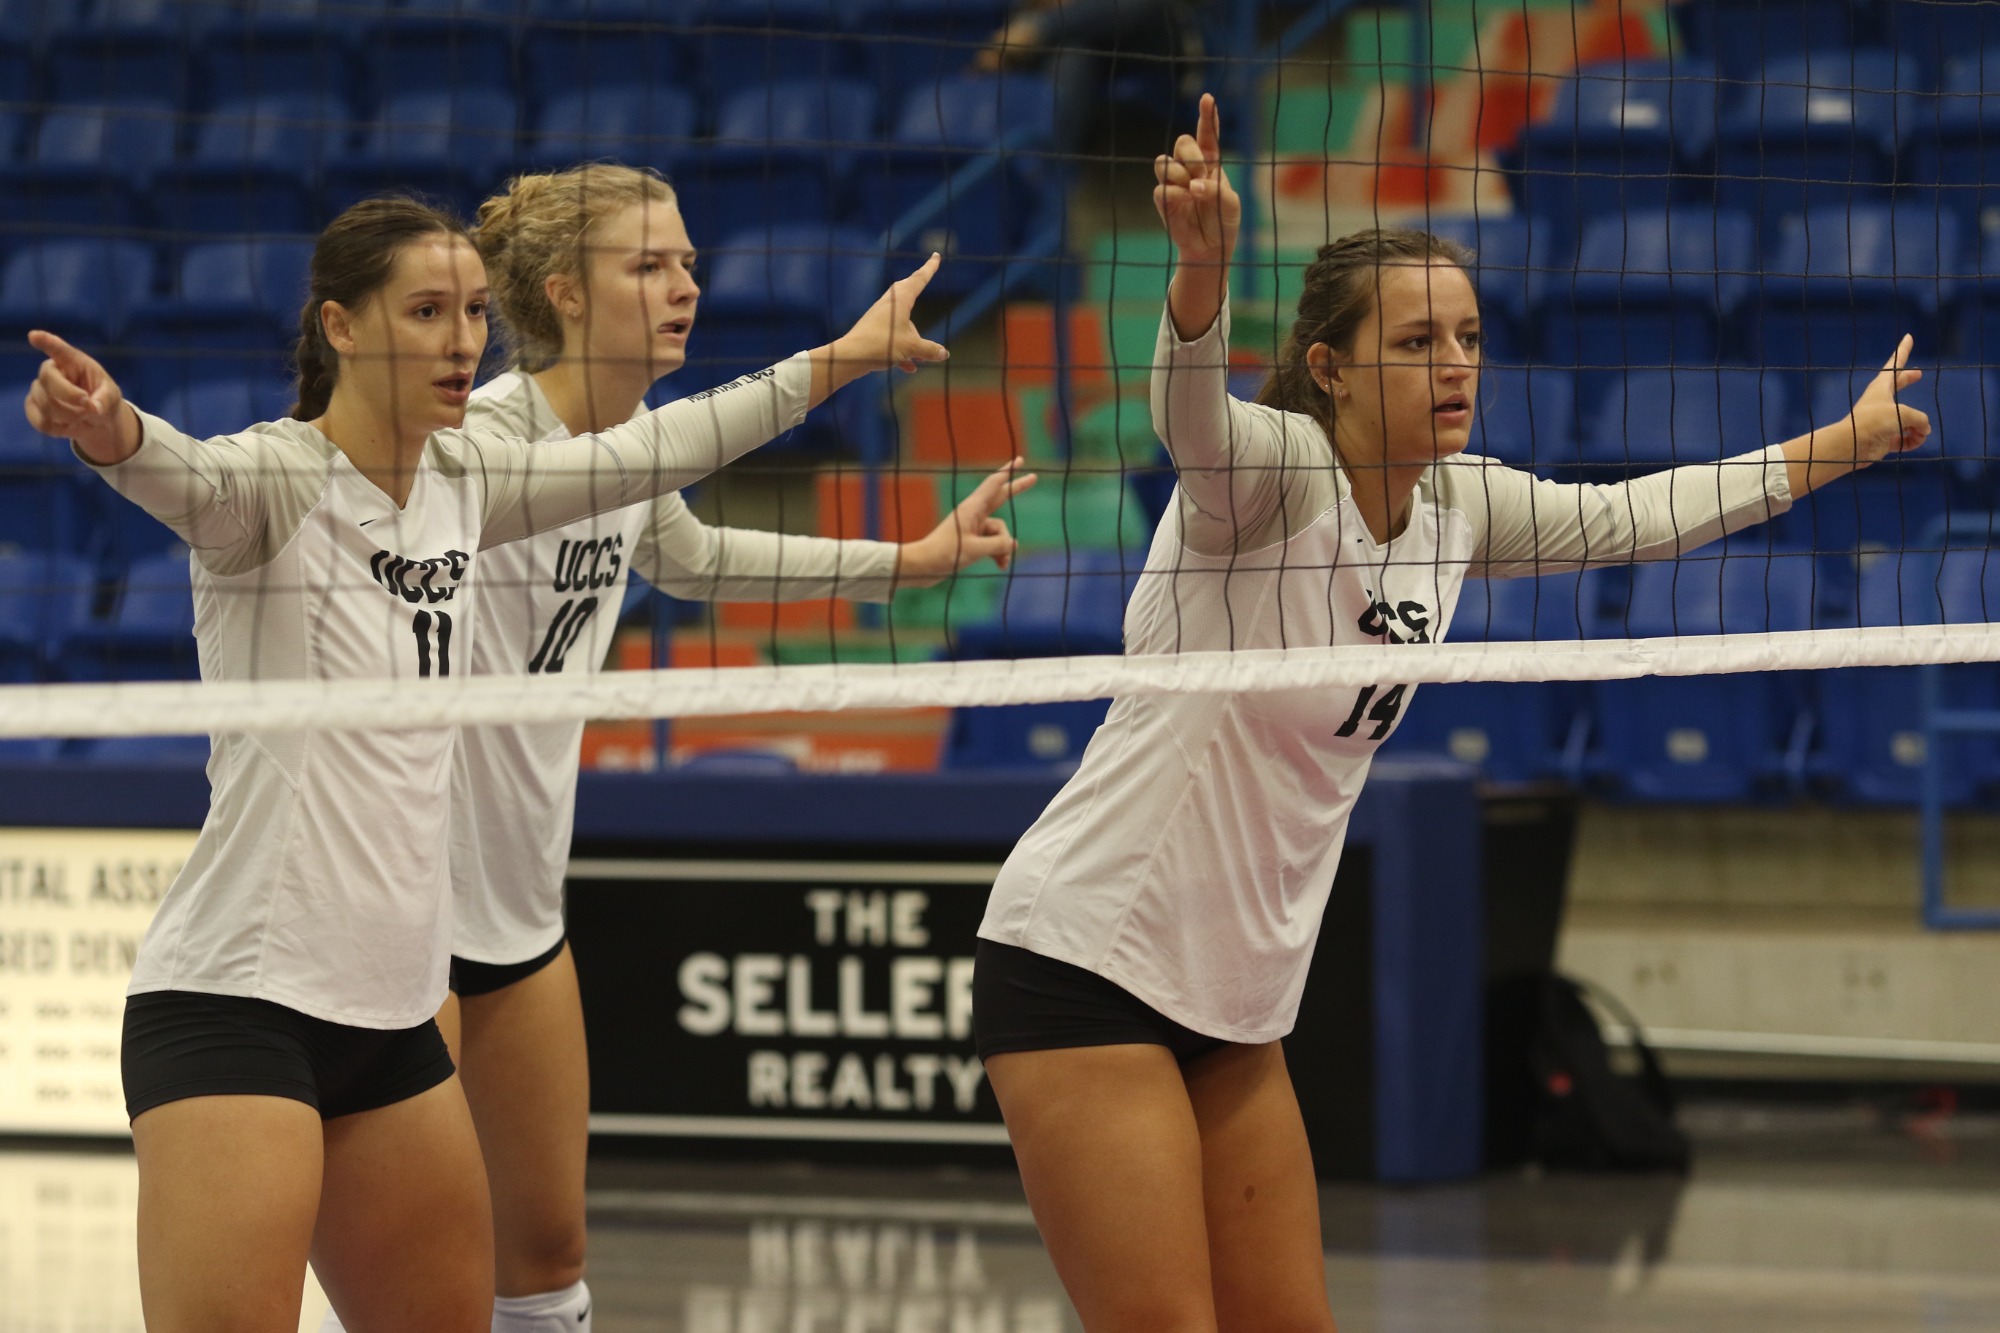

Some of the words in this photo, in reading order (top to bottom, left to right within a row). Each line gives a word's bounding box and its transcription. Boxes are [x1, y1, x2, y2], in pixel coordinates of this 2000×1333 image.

[553, 533, 623, 592] UCCS
[412, 609, 452, 677] 11
[528, 597, 598, 674] 10
[1333, 683, 1408, 740] 14
[806, 890, 929, 947] THE
[747, 1051, 985, 1112] REALTY
